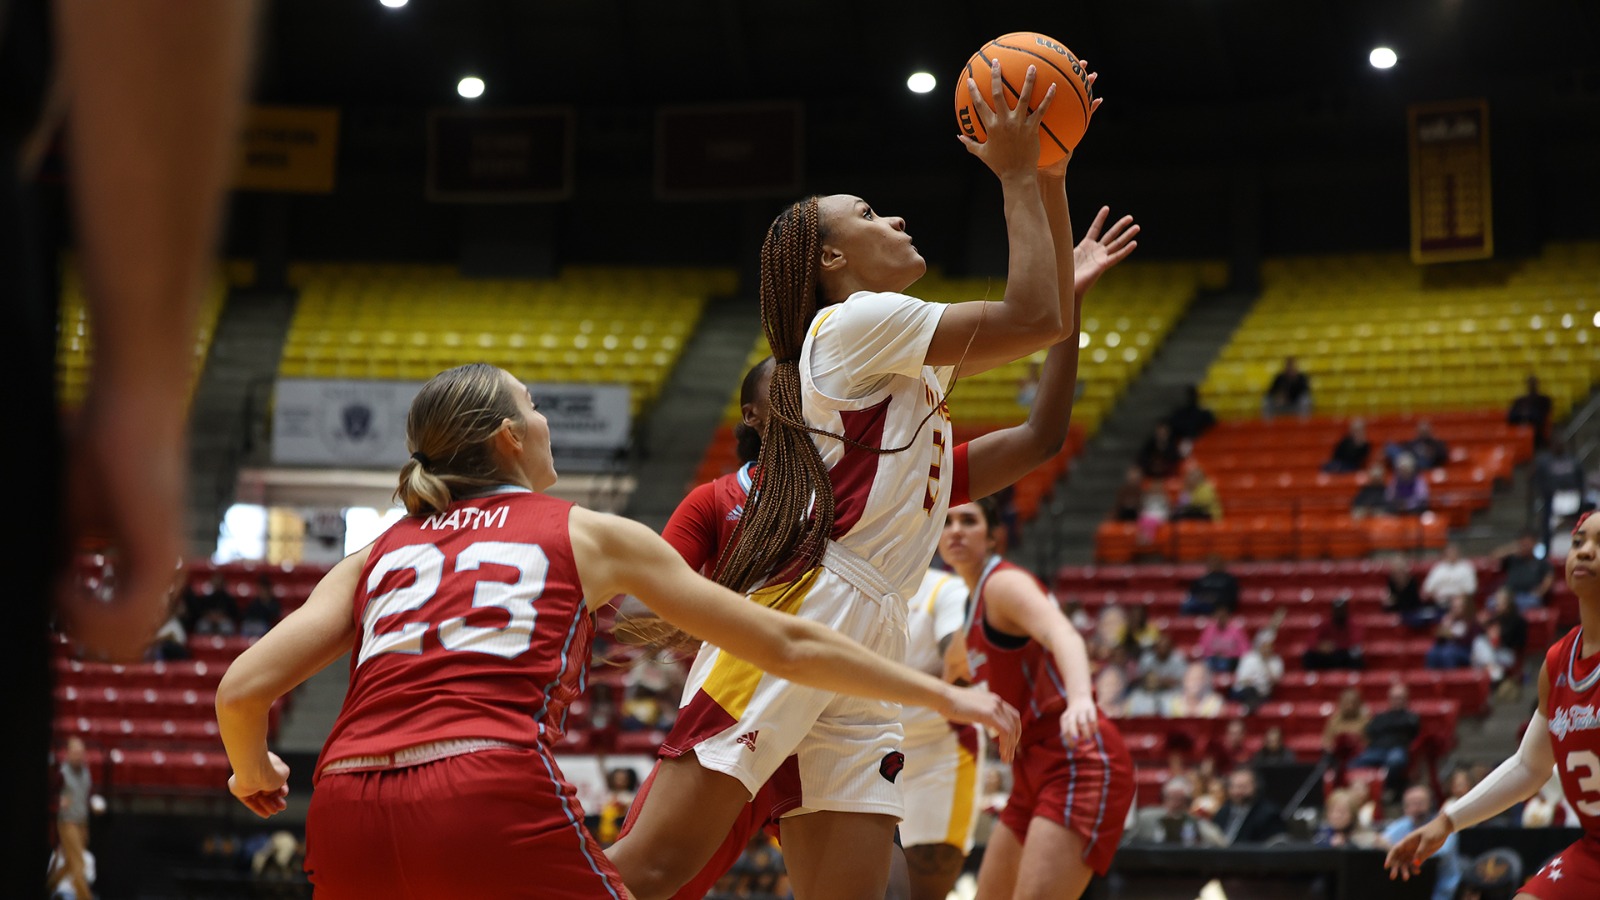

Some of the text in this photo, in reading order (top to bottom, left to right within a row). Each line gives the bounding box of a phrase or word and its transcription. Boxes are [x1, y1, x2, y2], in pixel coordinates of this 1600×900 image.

[420, 505, 510, 531] NATIVI
[357, 541, 549, 669] 23
[1566, 749, 1600, 817] 3
